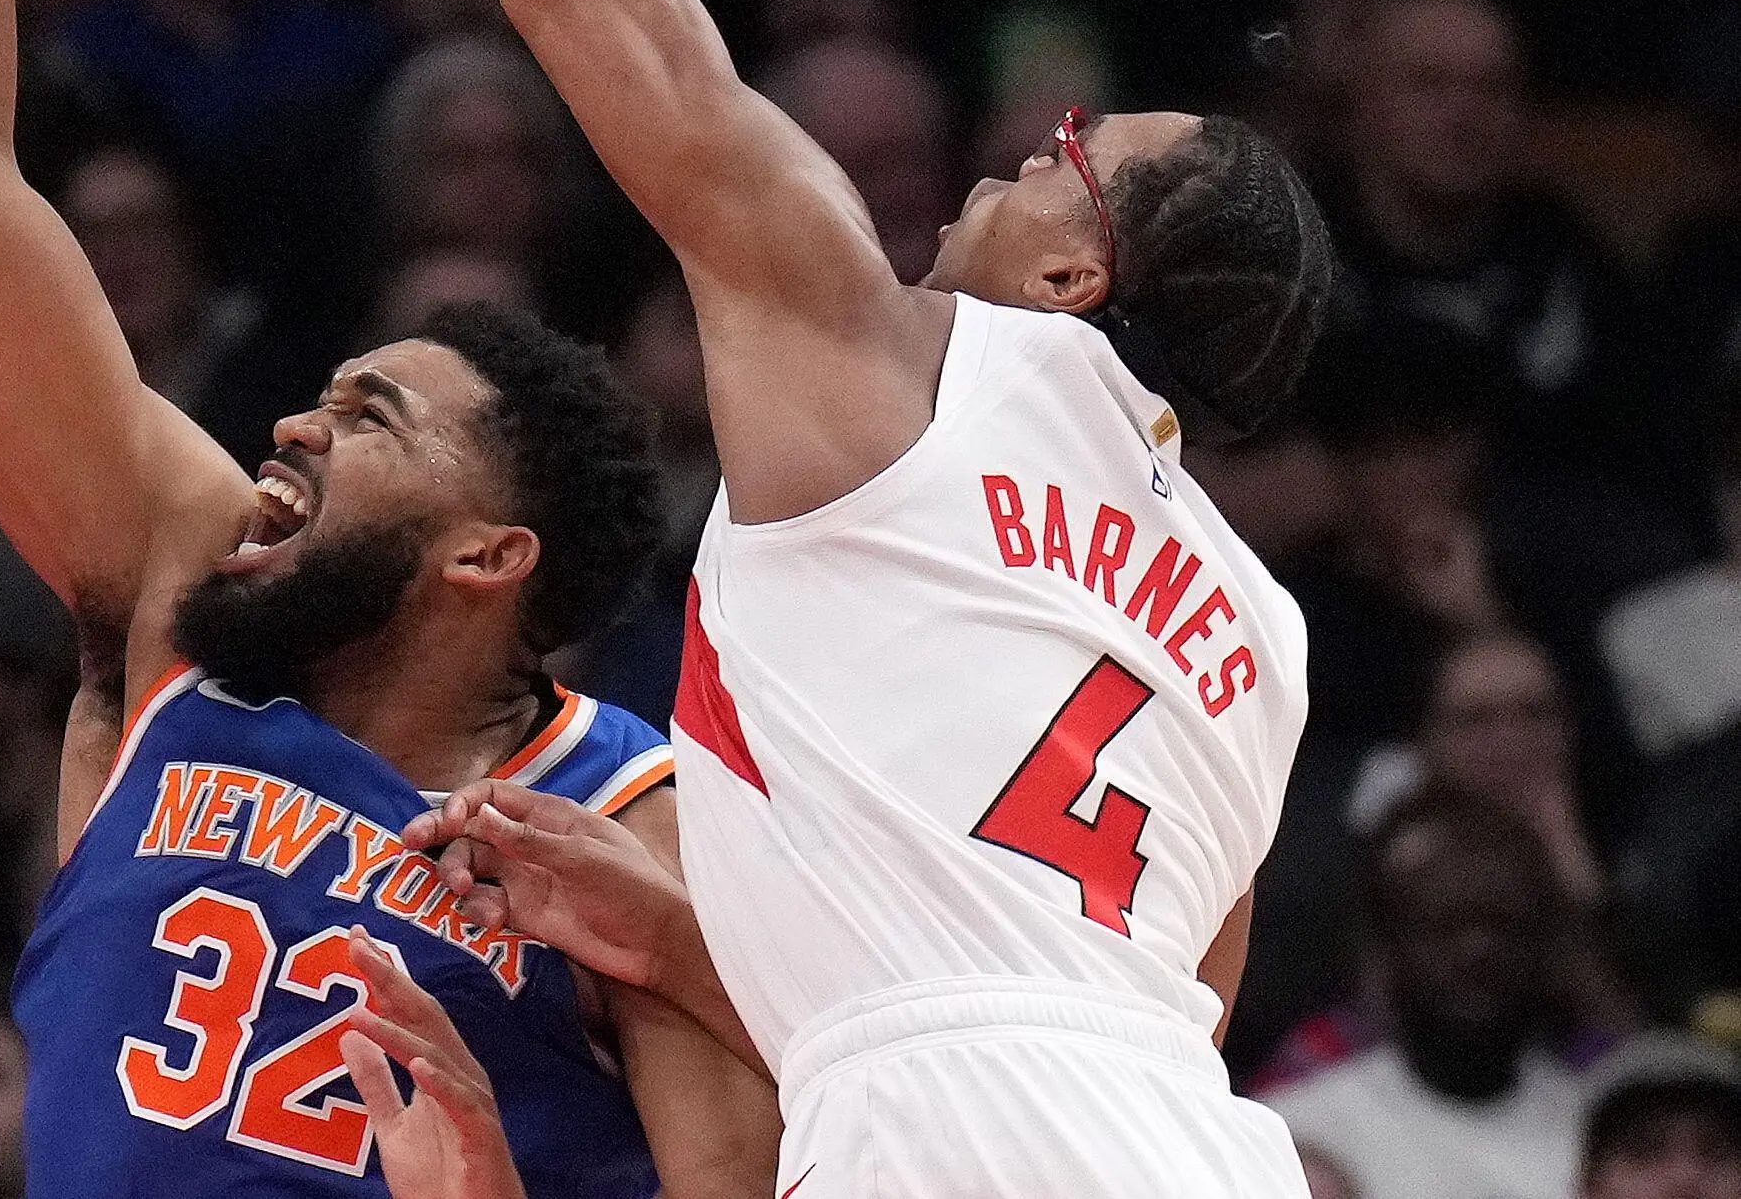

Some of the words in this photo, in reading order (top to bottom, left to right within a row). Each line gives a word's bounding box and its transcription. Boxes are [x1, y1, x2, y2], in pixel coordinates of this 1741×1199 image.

[981, 473, 1258, 718] BARNES
[133, 761, 350, 877] NEW
[326, 811, 549, 1000] YORK
[968, 652, 1156, 940] 4
[116, 887, 411, 1178] 32
